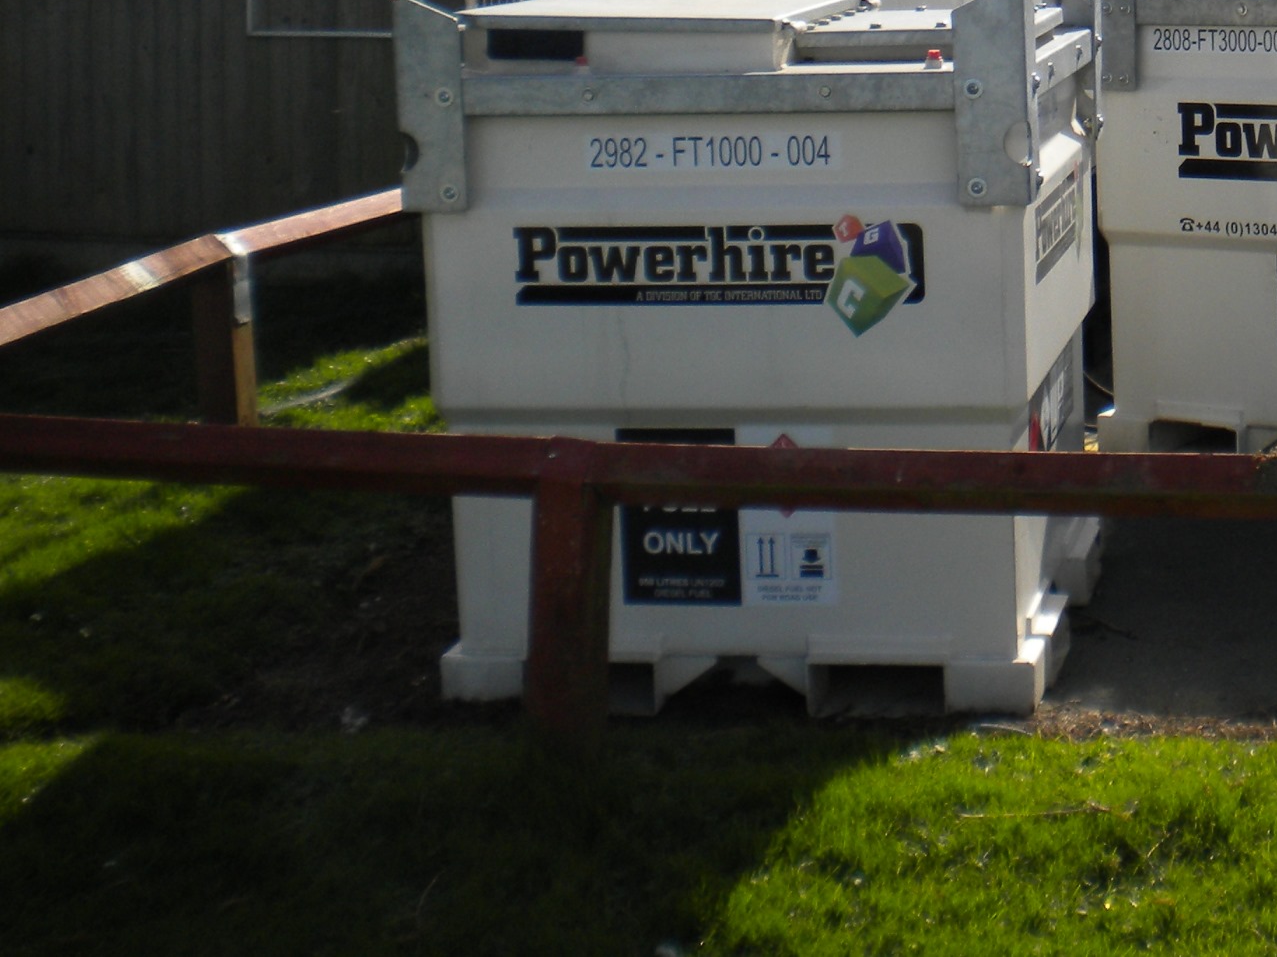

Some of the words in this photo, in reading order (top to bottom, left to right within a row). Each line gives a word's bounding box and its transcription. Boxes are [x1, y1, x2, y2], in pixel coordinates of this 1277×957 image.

[590, 136, 648, 168] 2982
[672, 136, 763, 167] FT1000
[786, 135, 832, 166] 004
[1196, 221, 1221, 234] +44
[512, 226, 835, 283] Powerhire
[636, 291, 643, 301] A
[645, 290, 688, 302] DIVISION
[690, 290, 700, 301] OF
[724, 289, 803, 301] INTERNATIONAL
[804, 289, 823, 300] LTD
[642, 531, 719, 556] ONLY
